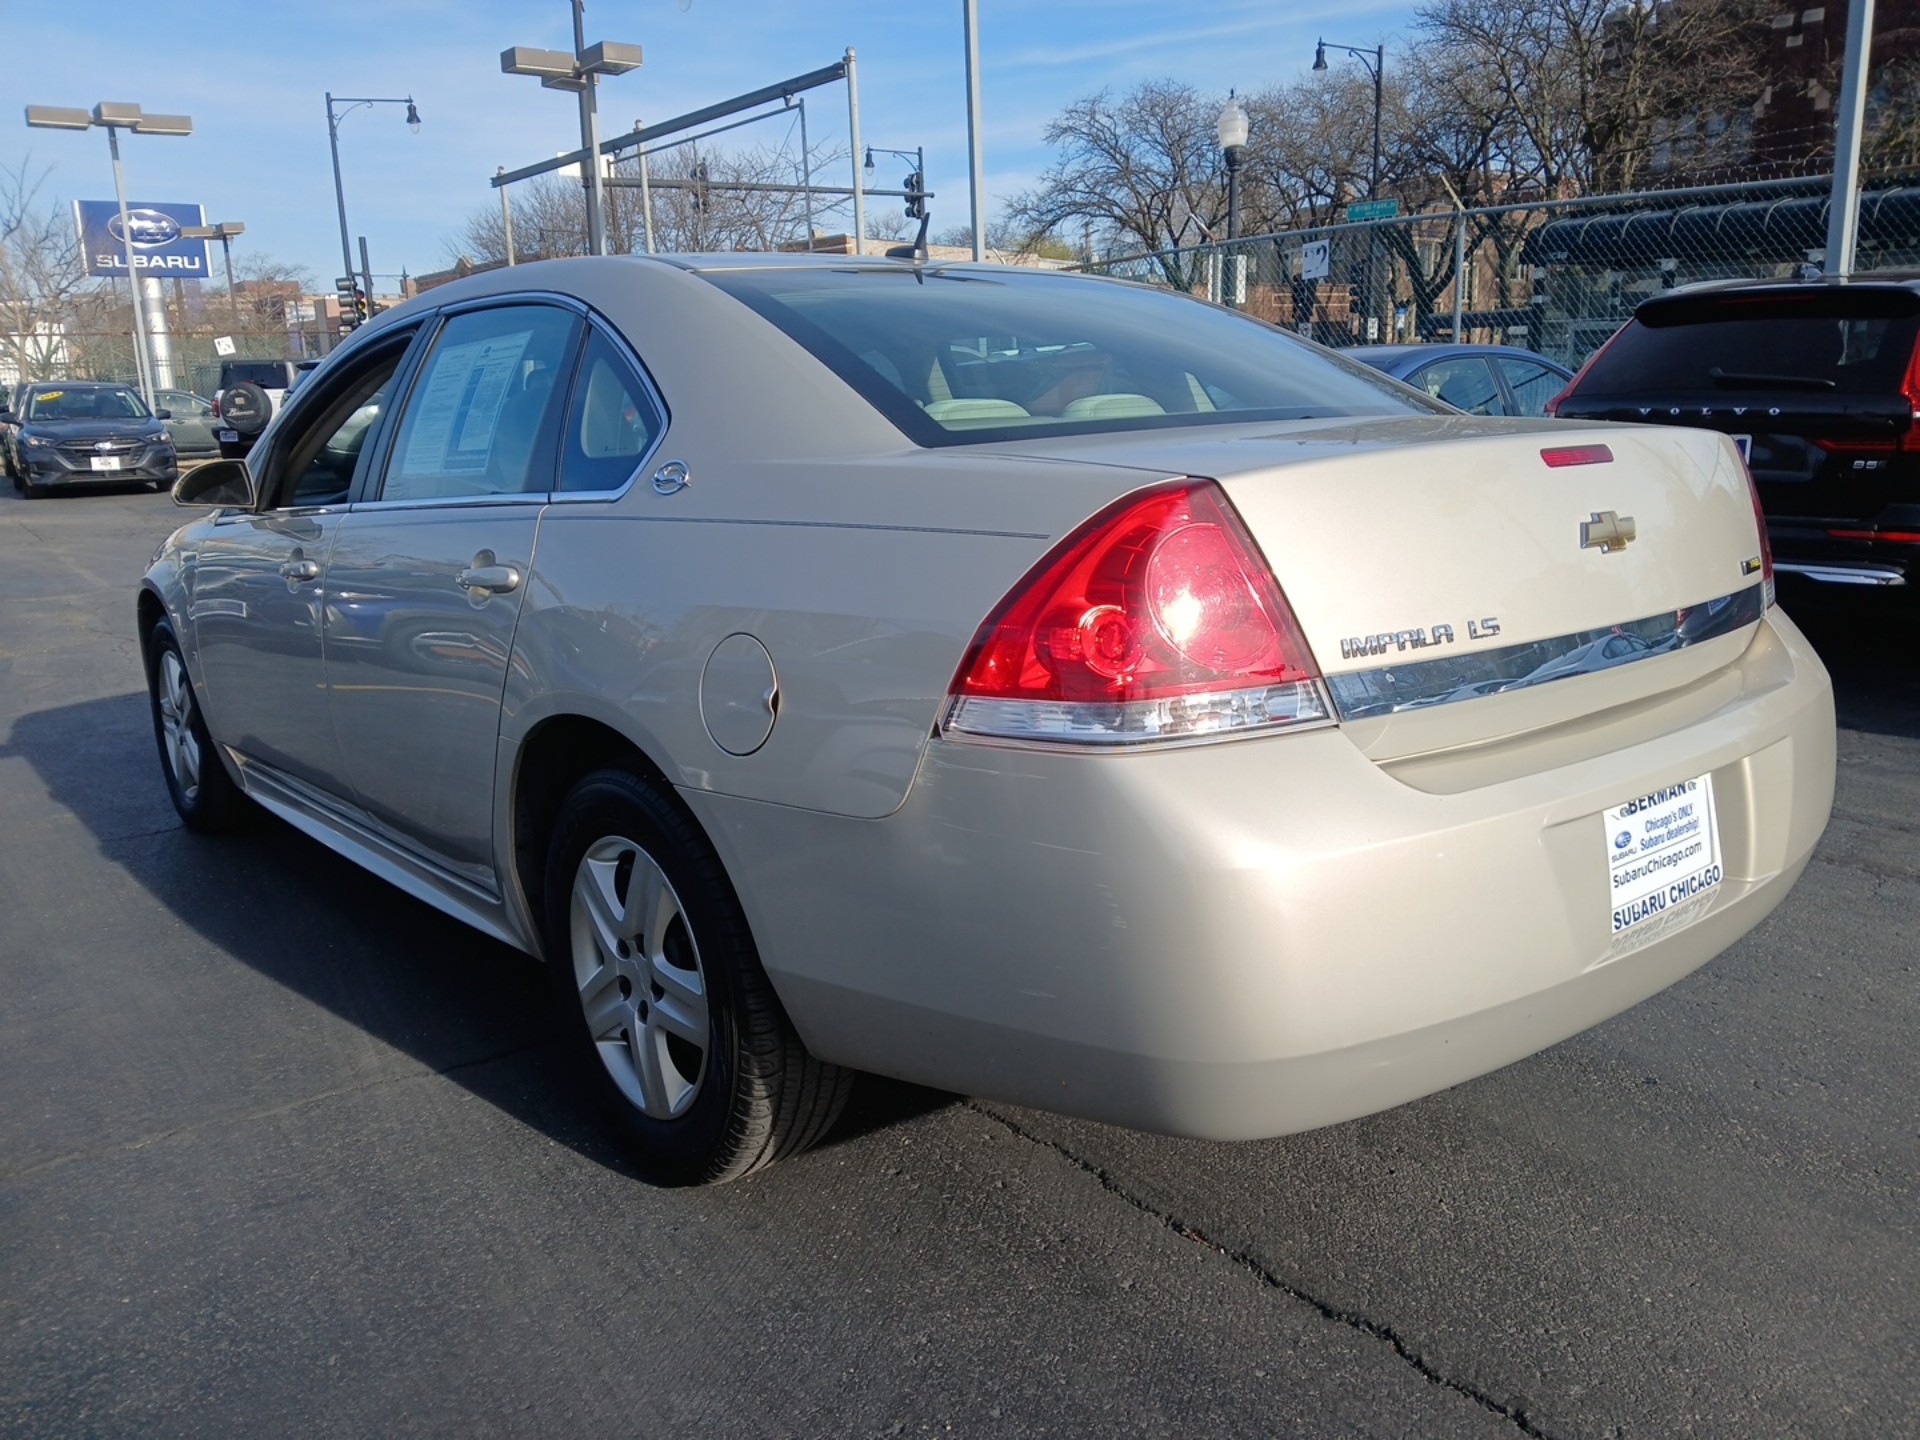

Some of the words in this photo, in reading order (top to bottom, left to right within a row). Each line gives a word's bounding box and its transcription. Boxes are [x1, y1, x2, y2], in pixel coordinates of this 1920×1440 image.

[95, 254, 201, 270] SUBARU
[1638, 406, 1781, 417] VOLVO
[1340, 623, 1454, 660] IMPALA
[1467, 616, 1501, 641] LS
[1627, 781, 1687, 815] BERMAN
[1644, 810, 1677, 833] Chicago's
[1677, 802, 1694, 821] ONLY
[1611, 846, 1638, 864] SUBARU
[1639, 833, 1666, 852] Subaru
[1612, 841, 1703, 889] SubaruChicago.com
[1612, 890, 1667, 931] SUBARU
[1669, 864, 1721, 904] CHICAGO
